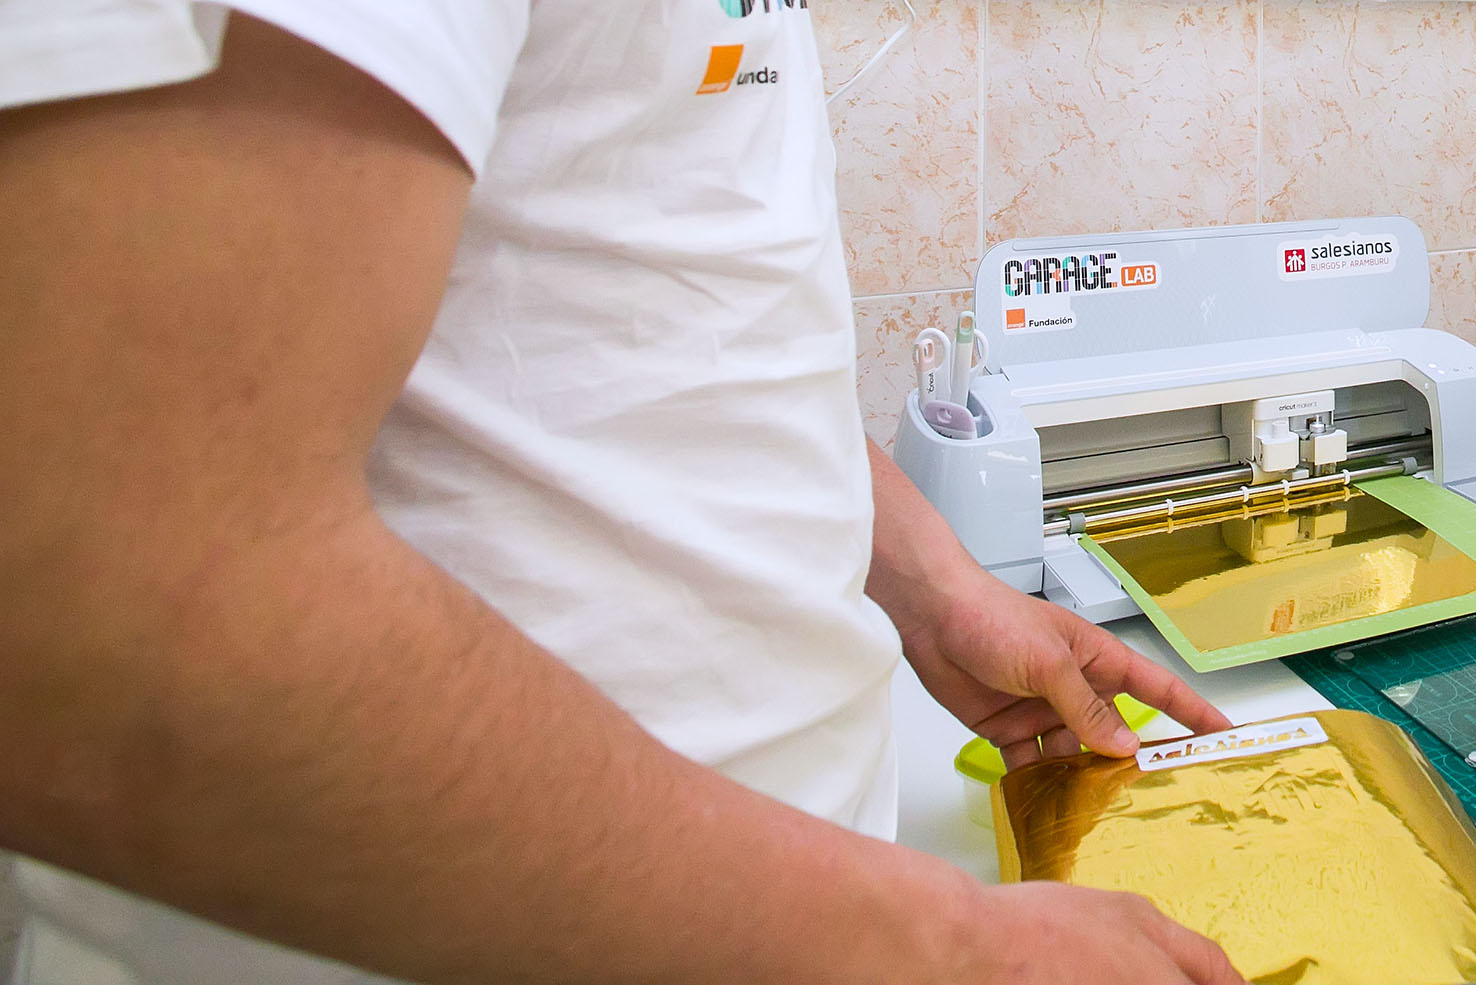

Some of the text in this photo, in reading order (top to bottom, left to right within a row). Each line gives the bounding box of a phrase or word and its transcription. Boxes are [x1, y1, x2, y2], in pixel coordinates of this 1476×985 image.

[1311, 241, 1393, 259] salesianos
[1311, 262, 1340, 271] BURGOS
[1350, 257, 1389, 268] ARAMBURU
[1004, 252, 1155, 297] GARAGE LAB
[1028, 317, 1073, 328] Fundación
